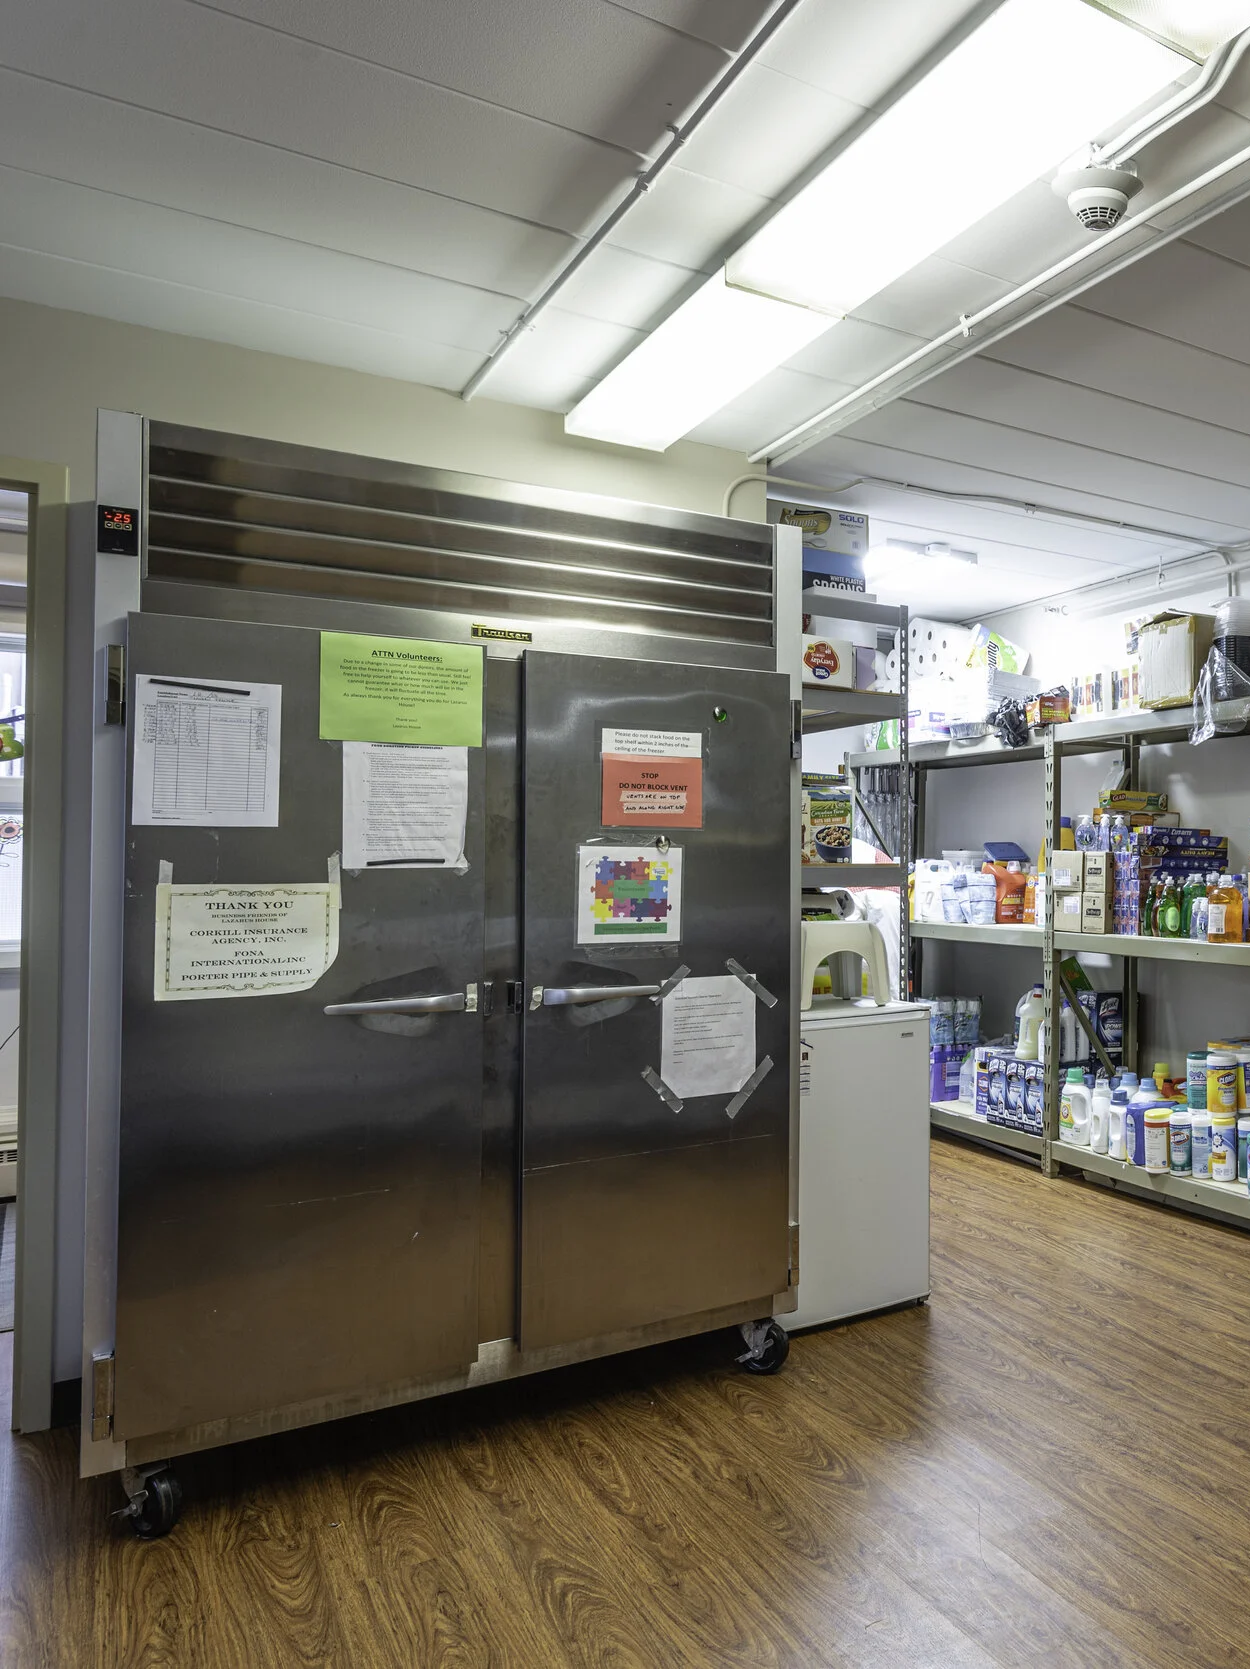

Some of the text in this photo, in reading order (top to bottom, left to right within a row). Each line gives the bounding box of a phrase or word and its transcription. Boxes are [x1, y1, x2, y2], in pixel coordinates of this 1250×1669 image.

[839, 514, 865, 524] SOLO
[830, 575, 864, 585] WHITE PLASTIC
[371, 650, 443, 662] ATTN Volunteers:
[811, 656, 834, 666] Everyday
[1112, 793, 1126, 801] GLAD
[205, 901, 294, 910] THANK YOU
[190, 927, 308, 937] CORKILL INSURANCE
[212, 937, 262, 945] AGENCY,
[181, 973, 229, 981] PORTER
[231, 971, 258, 979] PIPE
[270, 968, 313, 977] SUPPLY
[1219, 1075, 1236, 1084] CLOROX
